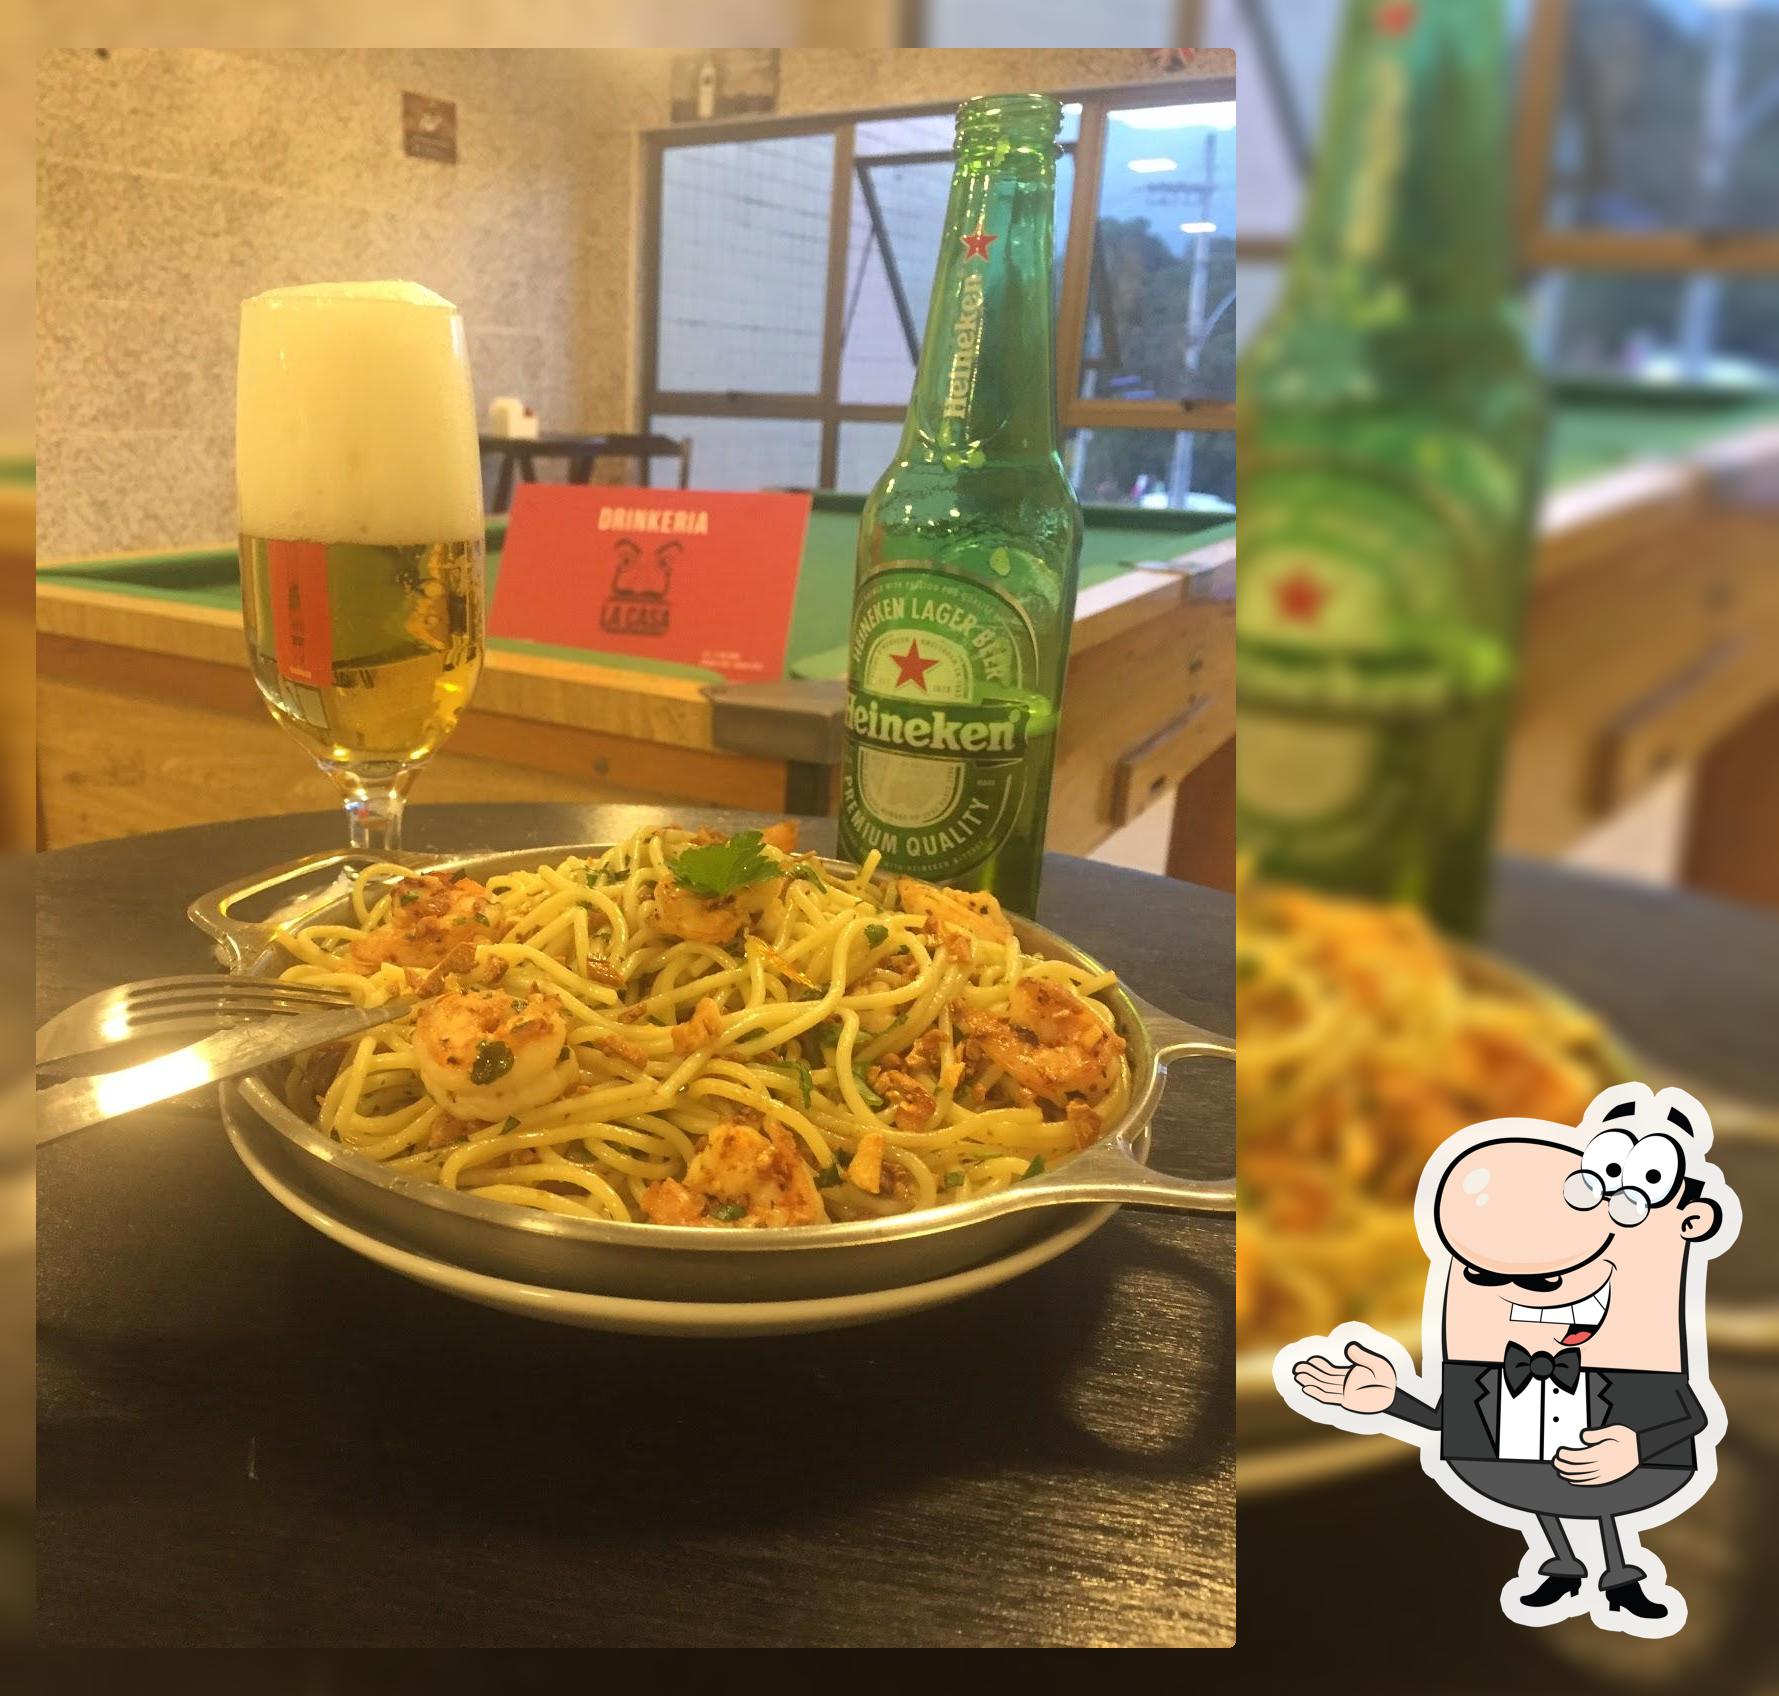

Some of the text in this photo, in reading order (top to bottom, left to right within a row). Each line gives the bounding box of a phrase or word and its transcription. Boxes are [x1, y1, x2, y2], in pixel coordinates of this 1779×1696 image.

[943, 274, 983, 419] Heineken
[597, 507, 709, 535] DRINKERIA
[601, 604, 670, 630] LA CASA
[853, 597, 905, 663] HEINEKEN
[911, 598, 977, 637] LAGER
[844, 775, 898, 854] PREMIUM
[906, 797, 990, 857] QUALITY
